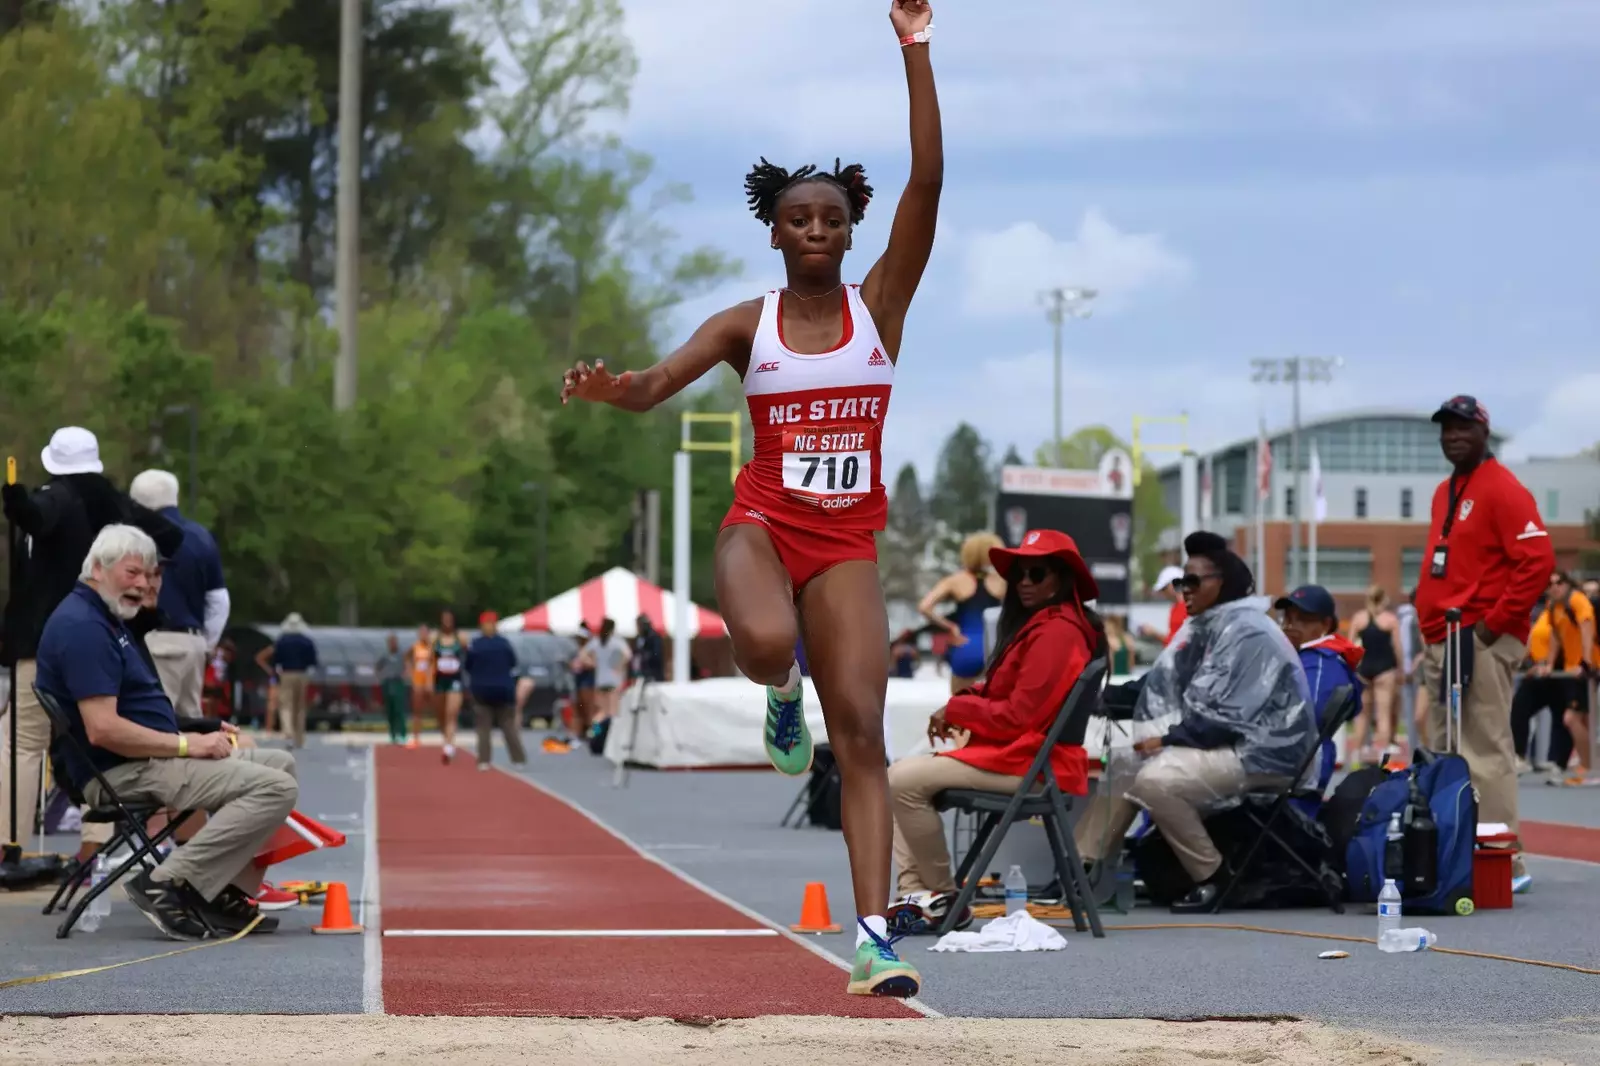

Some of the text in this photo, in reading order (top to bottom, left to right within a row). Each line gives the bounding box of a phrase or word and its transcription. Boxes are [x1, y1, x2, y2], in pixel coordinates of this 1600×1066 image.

[757, 361, 780, 371] ACC
[867, 358, 886, 367] adidas
[769, 396, 881, 425] NC STATE
[794, 432, 865, 452] NC STATE
[799, 455, 859, 490] 710
